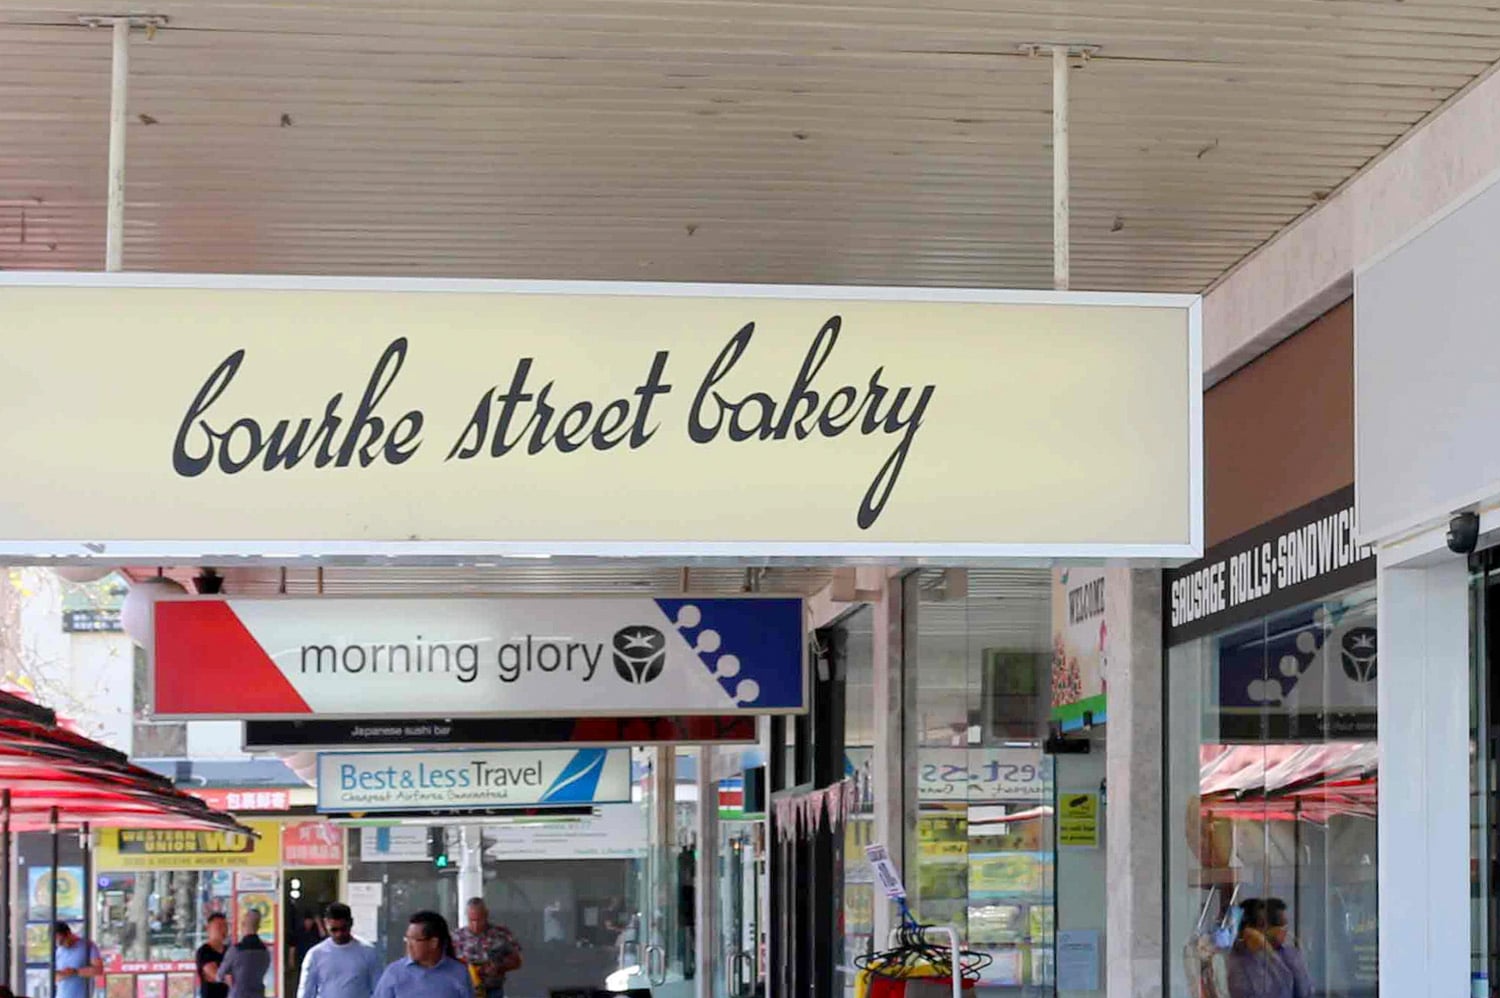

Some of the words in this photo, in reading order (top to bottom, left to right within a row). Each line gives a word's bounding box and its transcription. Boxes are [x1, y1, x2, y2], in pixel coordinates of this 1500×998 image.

[171, 336, 422, 478] bourke
[445, 350, 671, 461] street
[687, 314, 934, 529] bakery
[1172, 561, 1226, 627] SAUSAGE
[1230, 542, 1271, 606] ROLLS
[1278, 506, 1378, 588] SANDWICH
[1069, 577, 1105, 625] WELCOME
[300, 634, 478, 682] morning
[499, 633, 604, 682] glory
[351, 725, 402, 737] Japanese
[404, 725, 432, 736] sushi
[434, 725, 451, 736] bar
[471, 760, 543, 787] Travel
[145, 841, 196, 852] UNION
